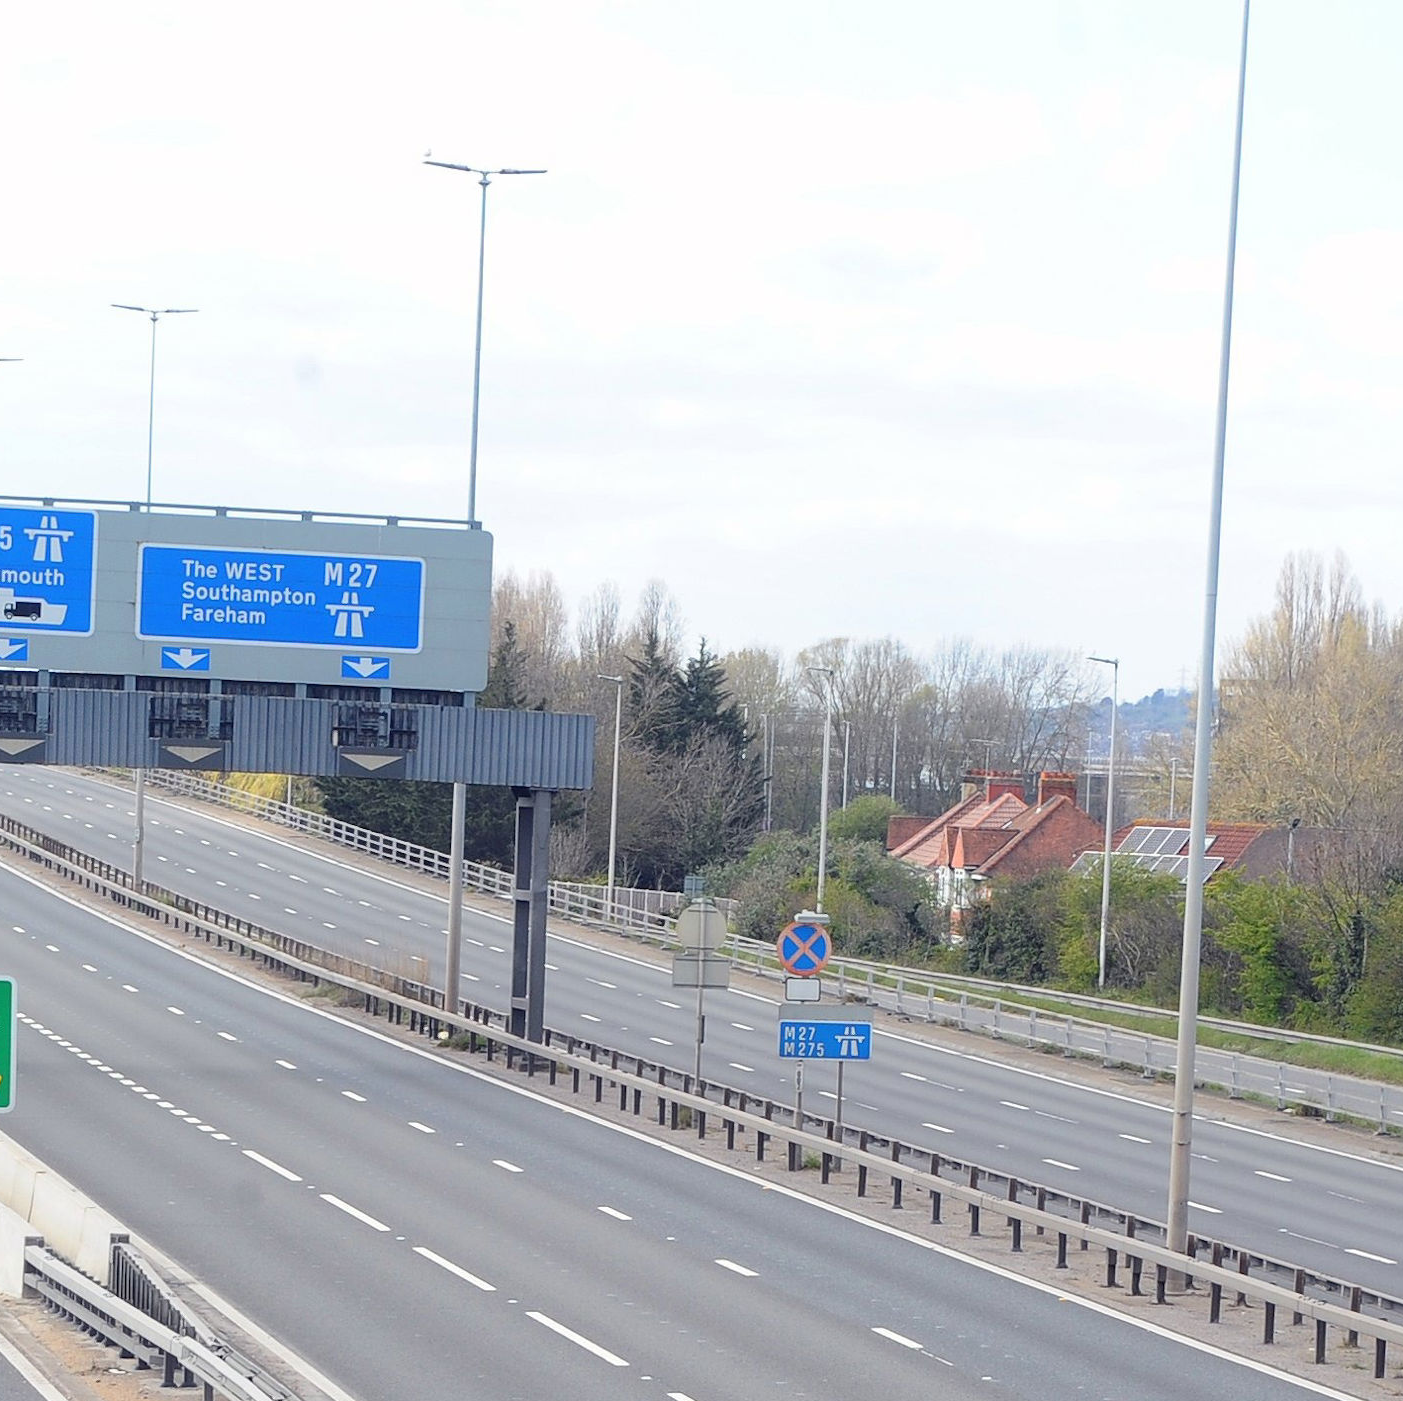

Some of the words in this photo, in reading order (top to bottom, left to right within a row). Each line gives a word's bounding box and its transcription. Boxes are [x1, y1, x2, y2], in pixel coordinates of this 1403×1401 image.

[181, 559, 218, 579] The
[225, 561, 285, 582] WEST
[181, 581, 316, 607] Southampton
[181, 603, 266, 625] Fareham
[784, 1026, 816, 1041] M27
[784, 1042, 824, 1057] M275
